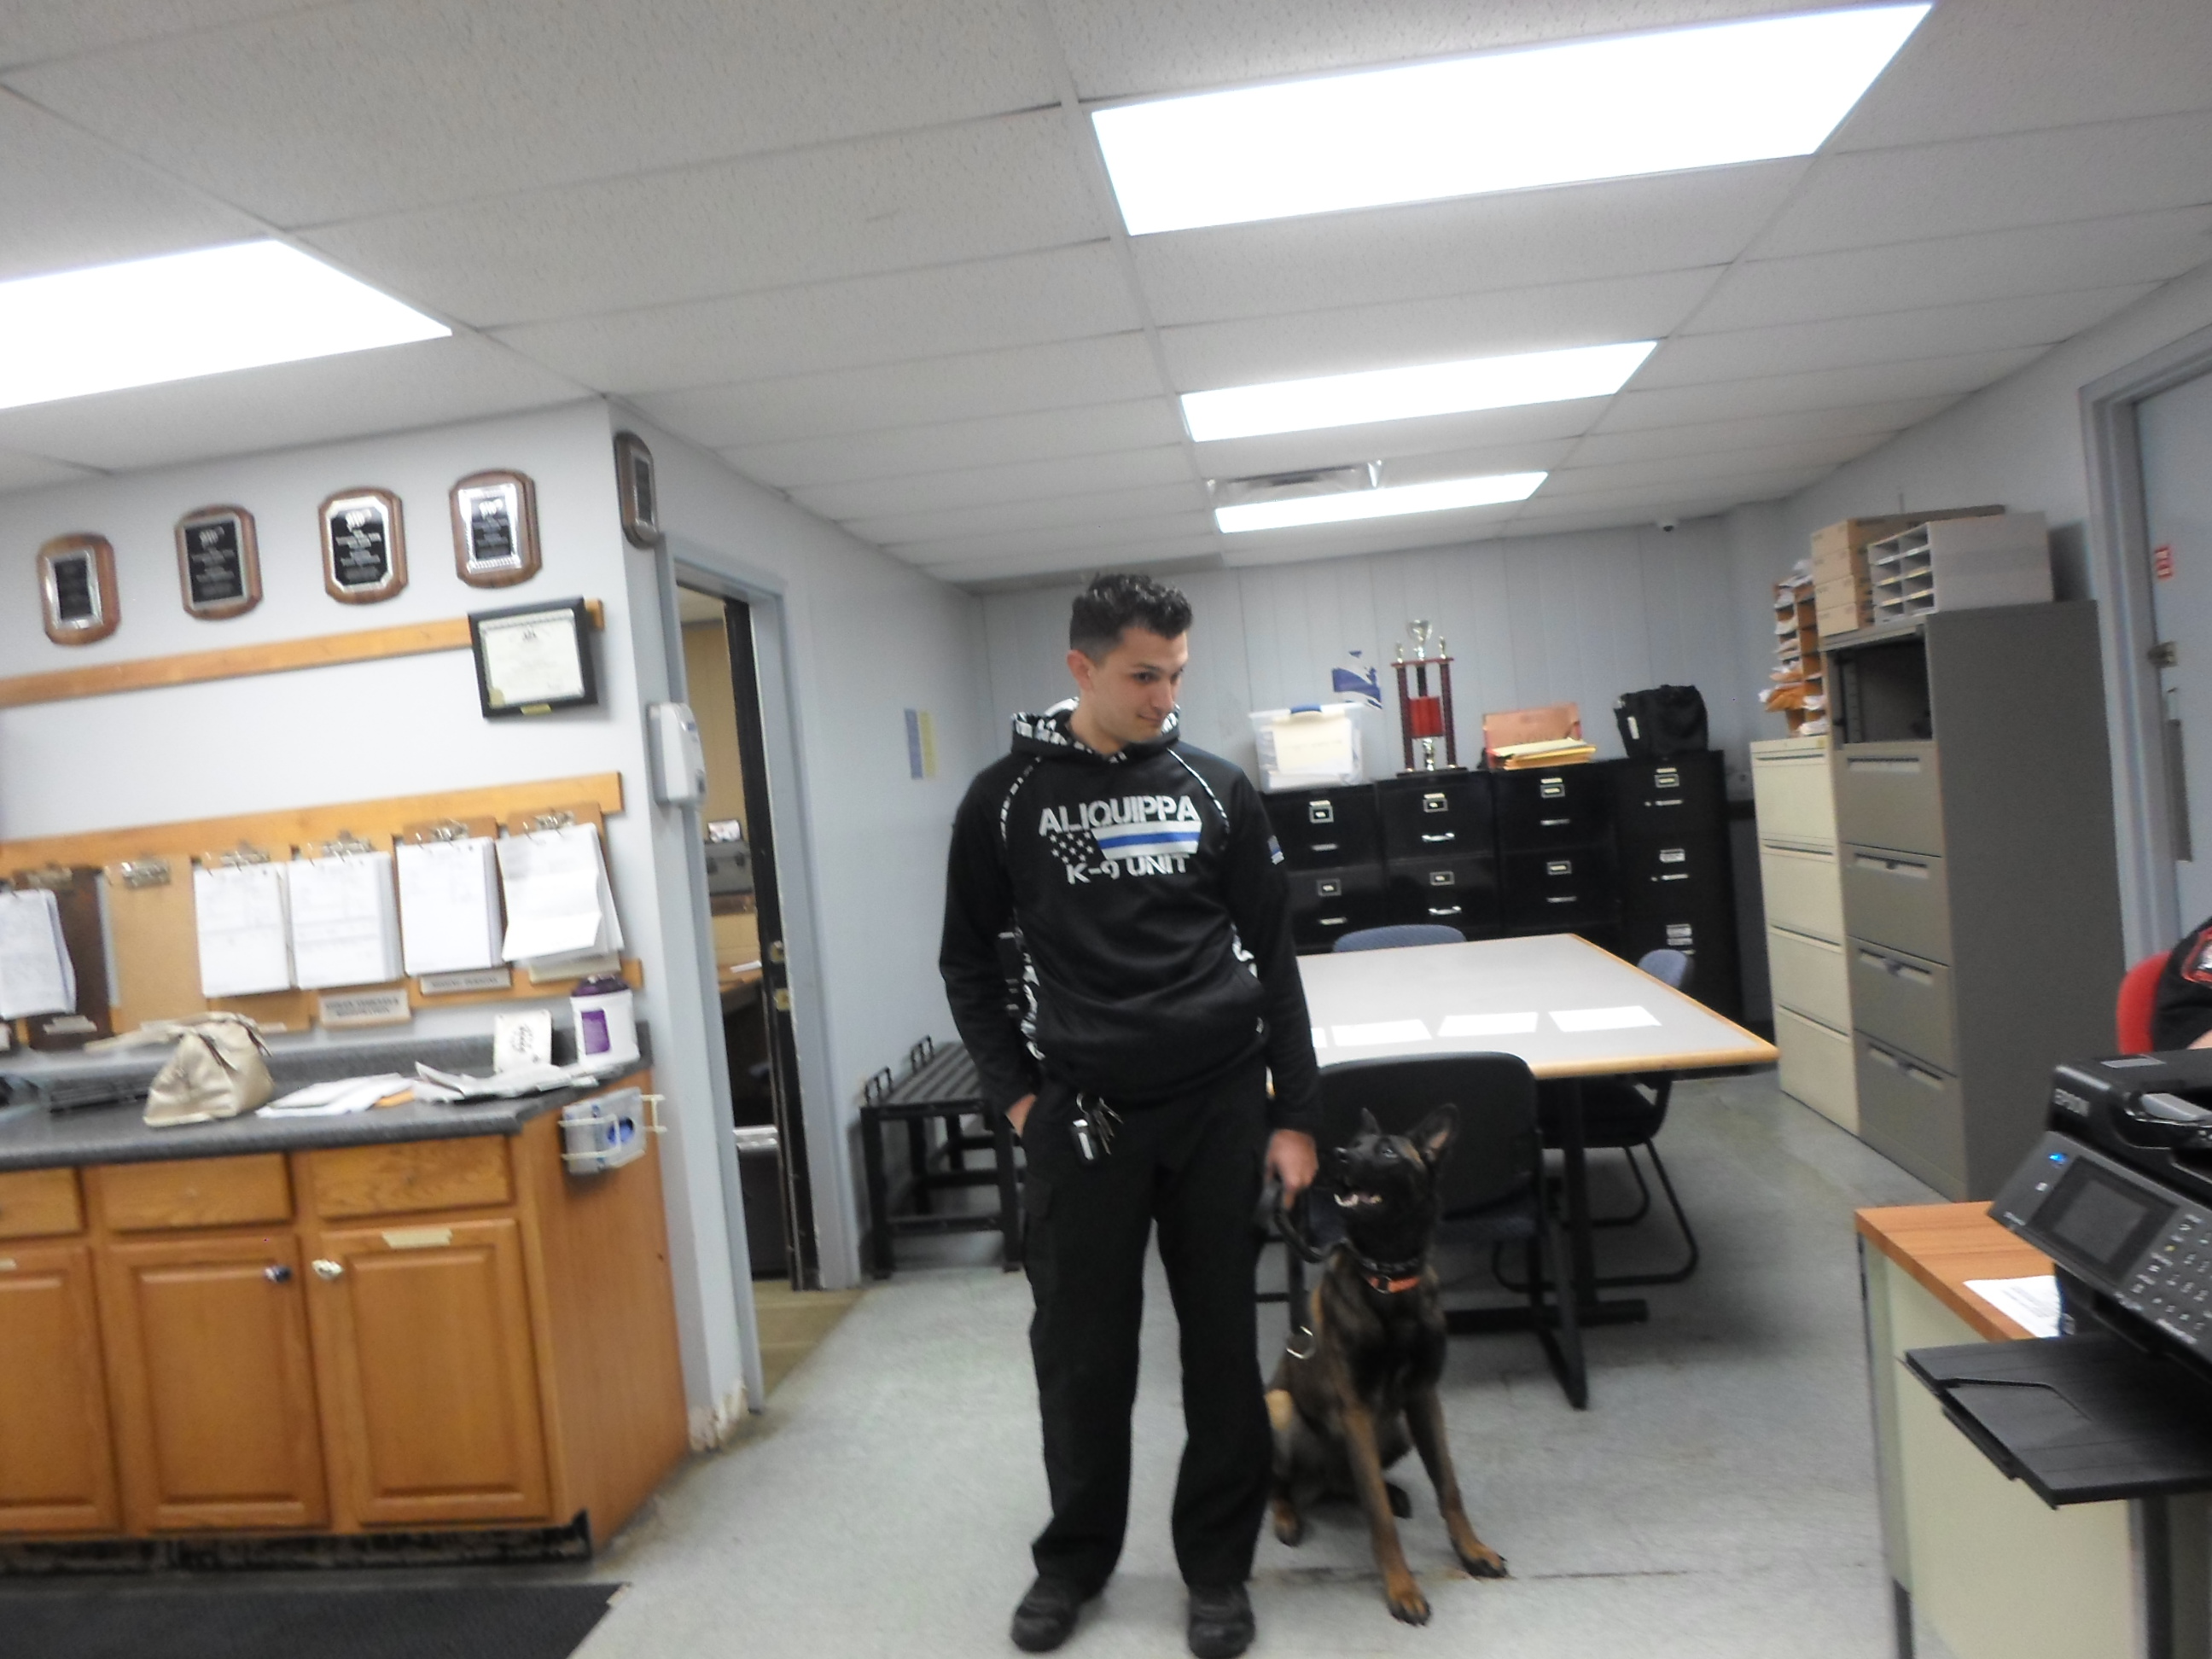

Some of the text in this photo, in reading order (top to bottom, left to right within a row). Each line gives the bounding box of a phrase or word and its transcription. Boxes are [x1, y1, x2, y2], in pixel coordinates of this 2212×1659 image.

[1039, 795, 1199, 835] ALIQUIPPA
[1066, 853, 1190, 884] K-9 UNIT
